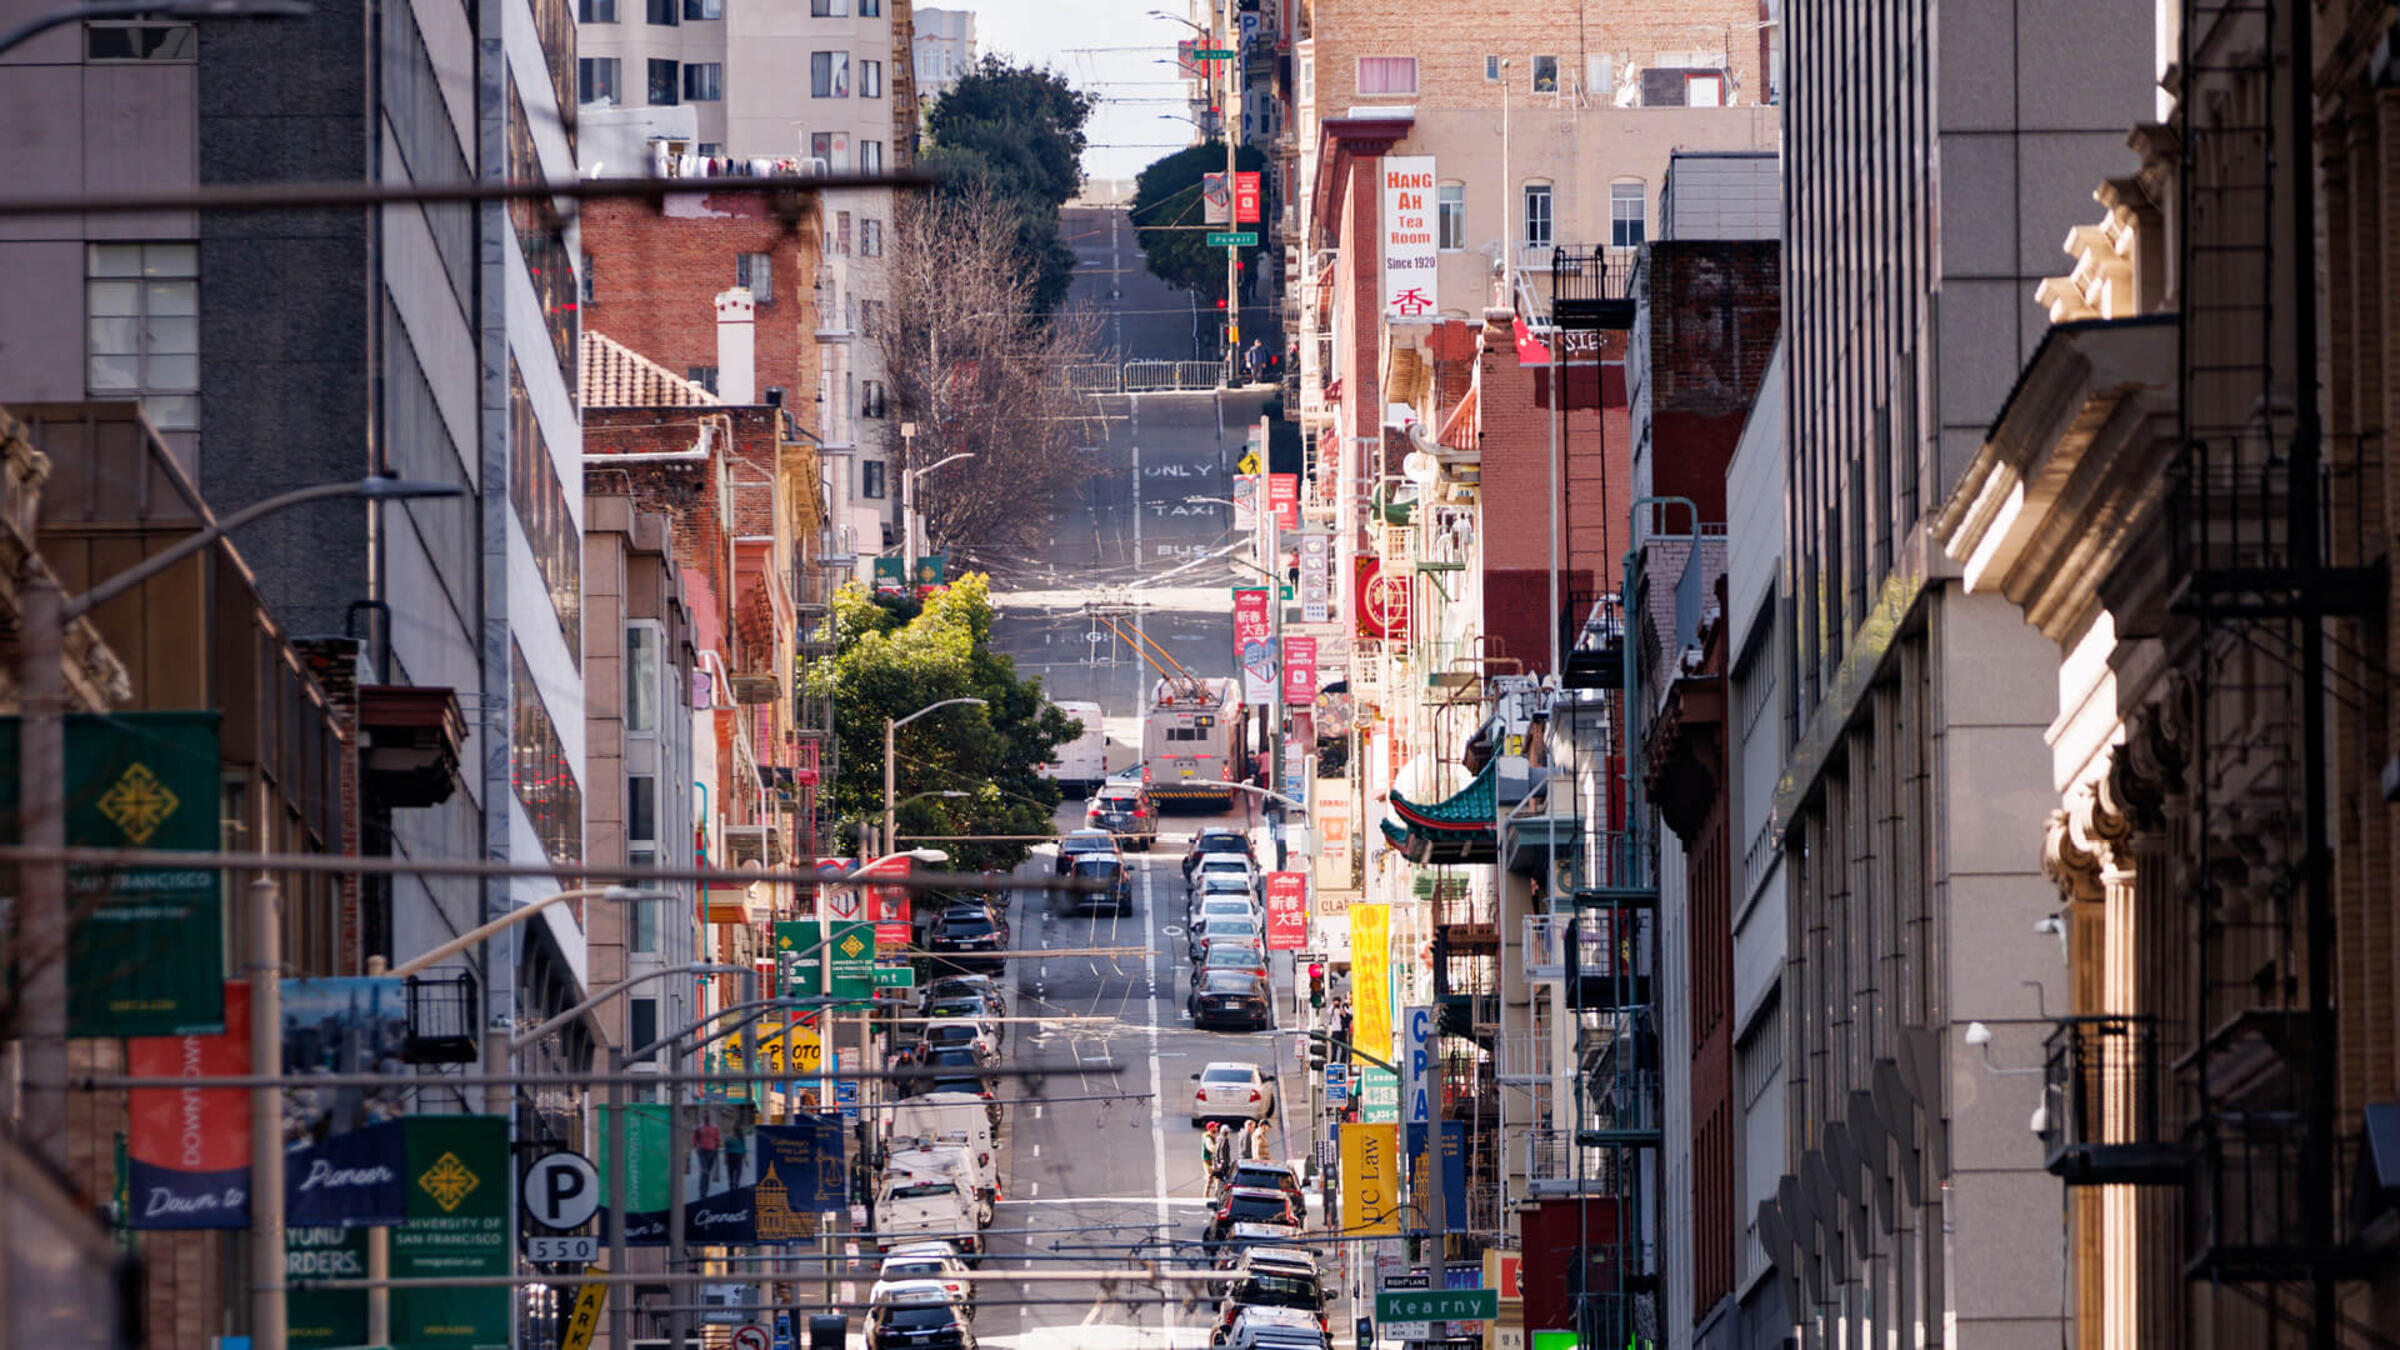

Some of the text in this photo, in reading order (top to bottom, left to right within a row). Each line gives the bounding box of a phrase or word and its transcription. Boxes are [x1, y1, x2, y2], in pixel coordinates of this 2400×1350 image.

[1387, 172, 1433, 189] HANG
[1398, 192, 1422, 210] AH
[1398, 216, 1424, 229] Tea
[1391, 232, 1431, 245] Room
[1387, 256, 1436, 270] Since 1920
[1391, 287, 1433, 316] 香
[1144, 464, 1213, 476] ONLY
[1152, 505, 1215, 516] TAXI
[1157, 545, 1206, 558] BUS
[1241, 623, 1266, 636] 大吉
[1269, 895, 1299, 910] 新春
[1276, 911, 1304, 926] 大吉
[769, 1044, 821, 1060] POTO
[1413, 1010, 1428, 1121] CPA
[300, 1159, 394, 1191] Pioneer
[1361, 1135, 1381, 1223] UC Law
[546, 1164, 585, 1220] P
[145, 1187, 245, 1217] Down to
[397, 1218, 501, 1230] NIVERSITY OF
[694, 1209, 749, 1231] Connect
[288, 1227, 345, 1246] YOND
[397, 1232, 502, 1245] SAN FRANCISCO
[537, 1241, 589, 1258] 550
[286, 1252, 362, 1274] RDERS.
[1386, 1277, 1427, 1286] RIGHT LANE
[572, 1285, 595, 1346] ARK
[1389, 1299, 1482, 1317] Kearny
